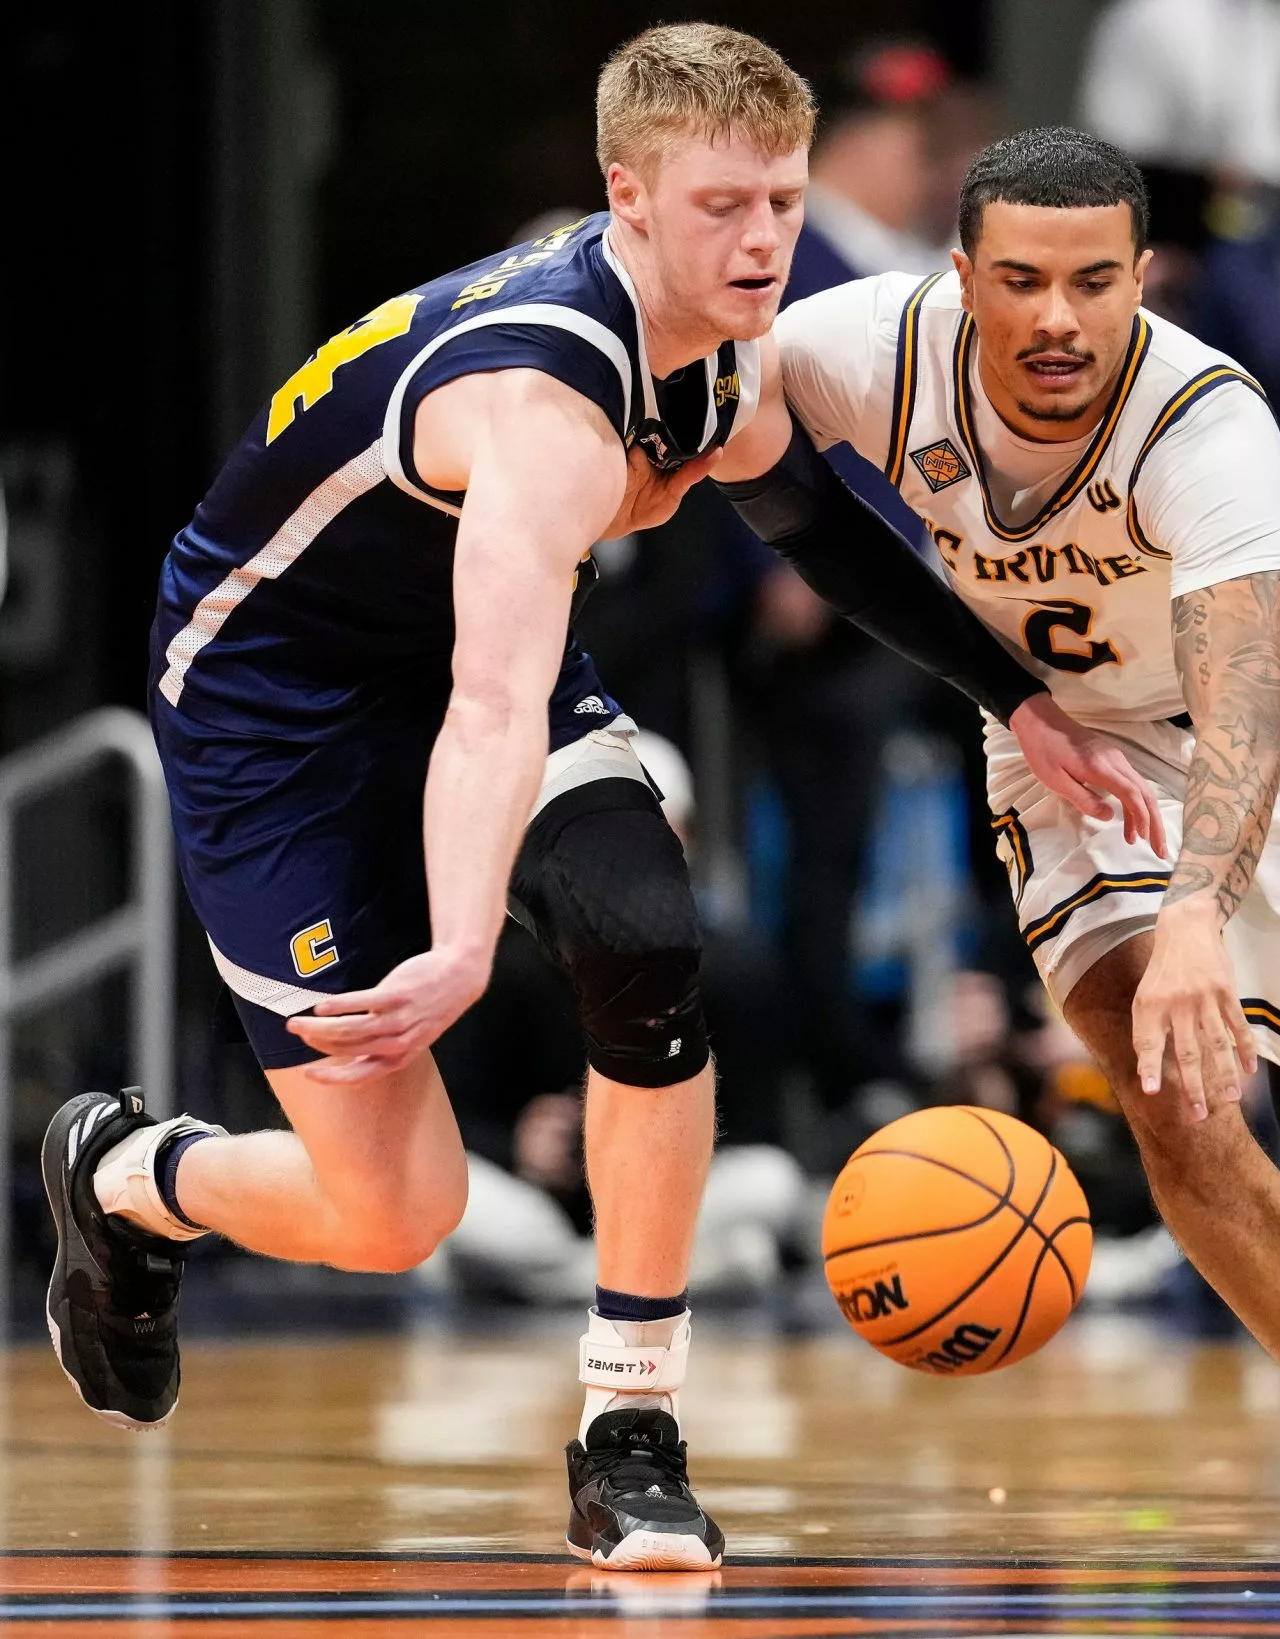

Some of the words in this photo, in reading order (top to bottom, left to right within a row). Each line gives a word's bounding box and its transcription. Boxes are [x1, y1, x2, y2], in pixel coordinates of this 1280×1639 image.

[925, 455, 958, 473] NIT
[974, 543, 1149, 586] IRVINE
[289, 918, 340, 978] C
